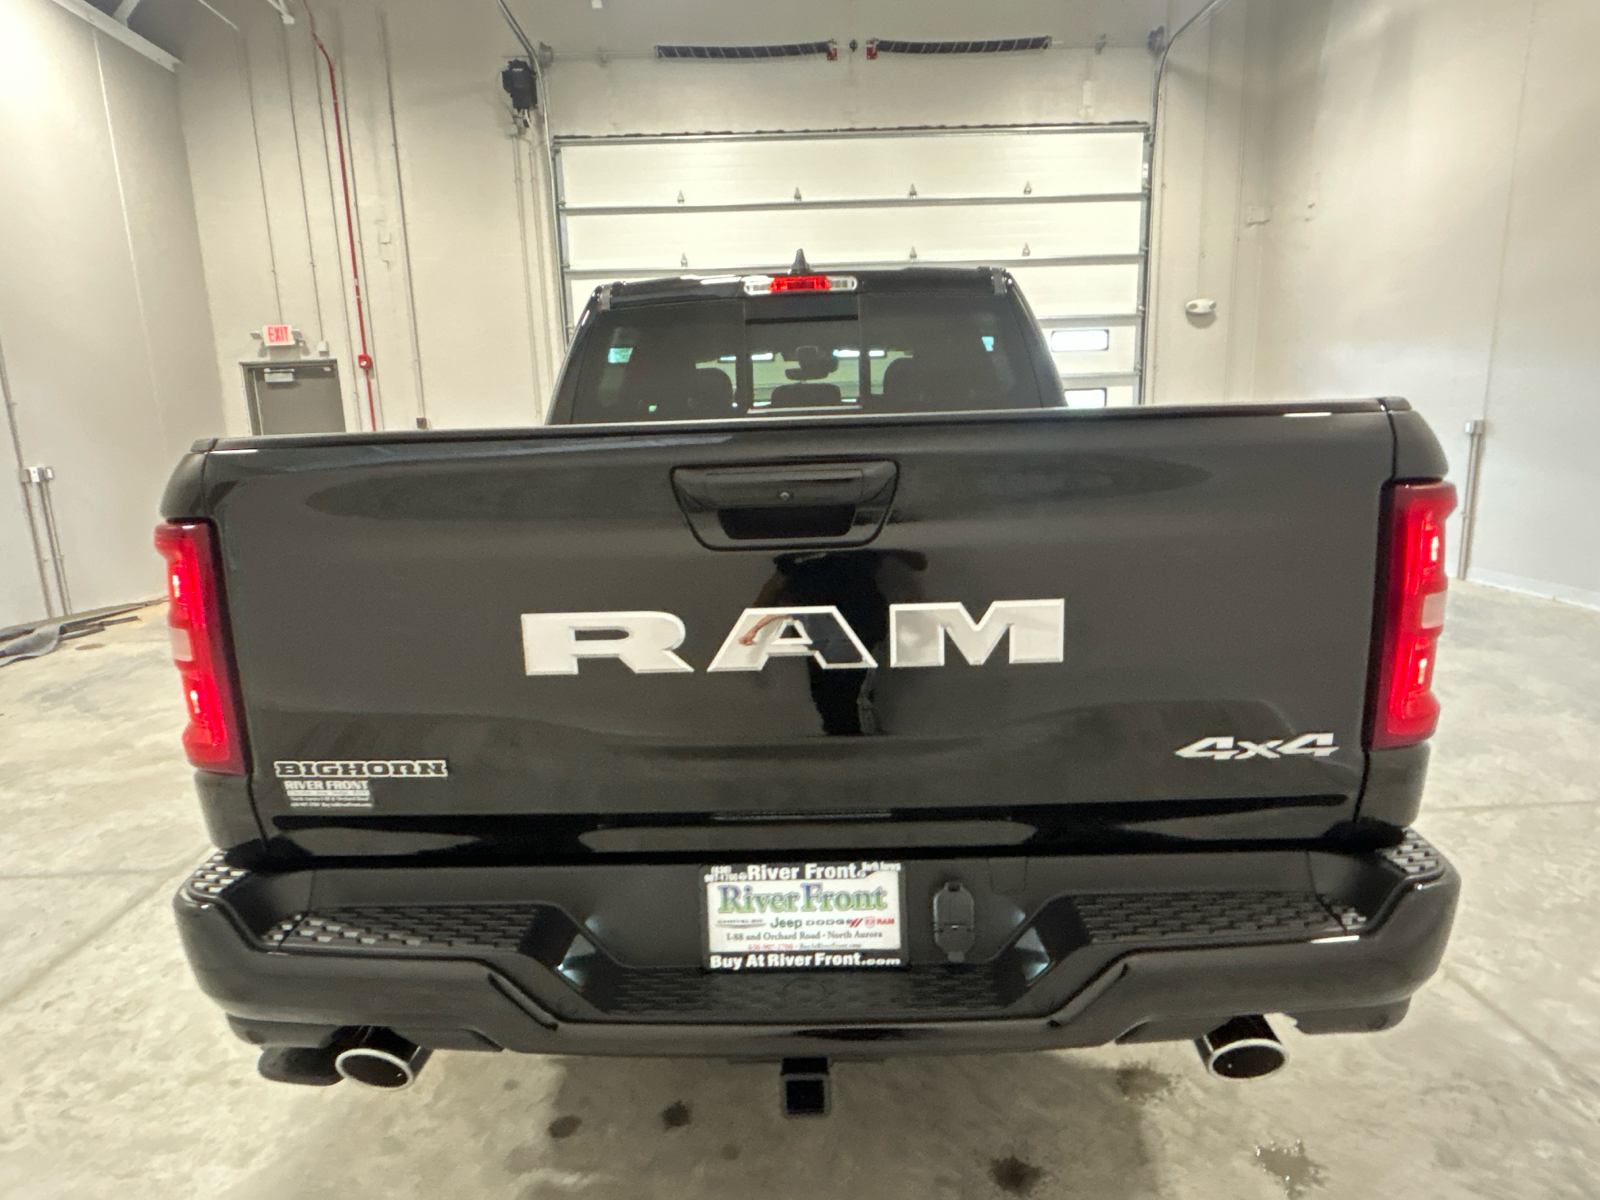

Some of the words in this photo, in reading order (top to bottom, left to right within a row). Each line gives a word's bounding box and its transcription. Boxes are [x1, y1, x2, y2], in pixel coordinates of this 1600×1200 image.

[267, 326, 289, 343] EXIT
[520, 598, 1065, 676] RAM
[1175, 732, 1340, 760] 4x4
[274, 760, 448, 778] BIGHORN
[284, 780, 324, 790] RIVER
[326, 780, 369, 790] FRONT
[747, 864, 799, 880] River
[804, 862, 856, 880] Front
[770, 917, 803, 930] Jeep
[745, 932, 761, 941] and
[763, 931, 798, 941] Orchard
[799, 931, 820, 940] Road
[827, 930, 853, 940] North
[854, 930, 883, 939] Aurora
[710, 954, 743, 970] Buy
[746, 953, 765, 968] At
[767, 953, 811, 968] River
